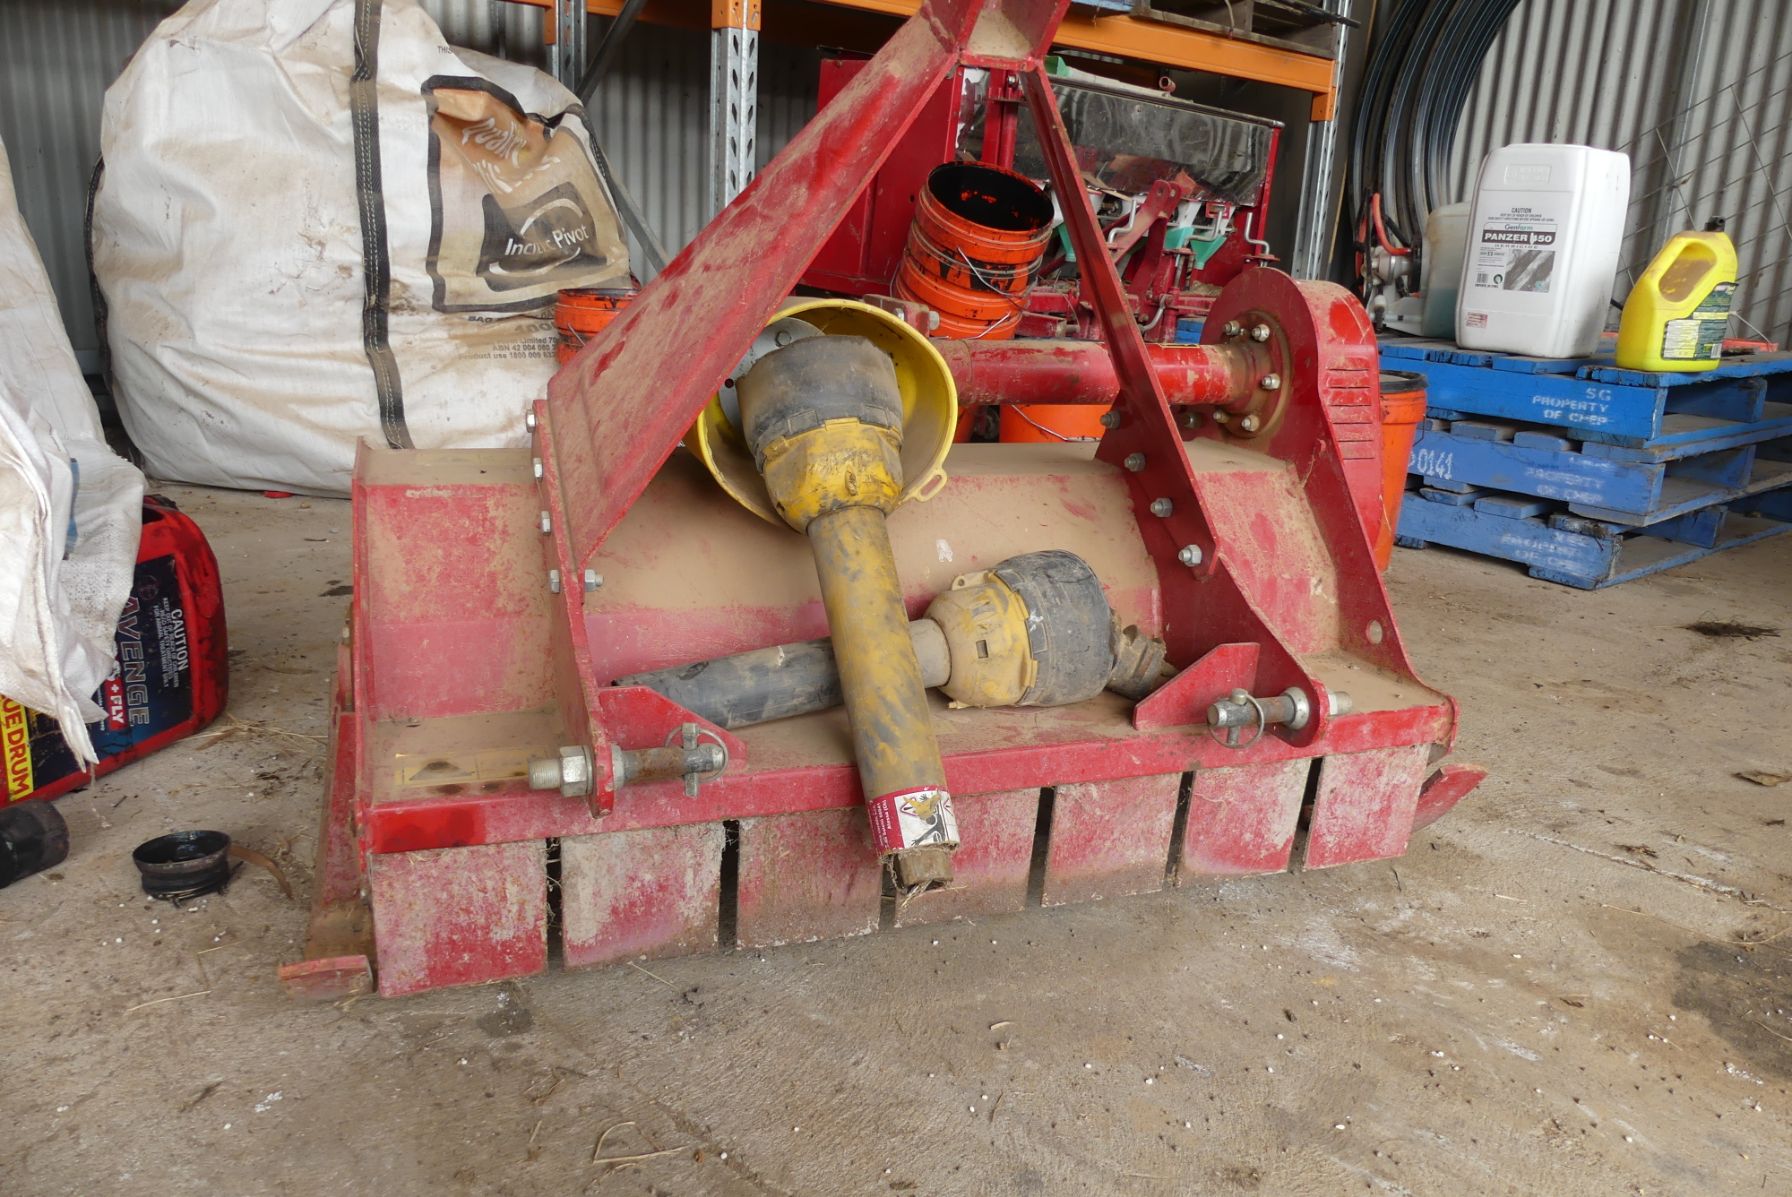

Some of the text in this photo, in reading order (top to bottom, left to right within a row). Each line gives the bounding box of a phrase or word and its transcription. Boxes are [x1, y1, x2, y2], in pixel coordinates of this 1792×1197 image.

[552, 224, 589, 249] Pivot
[1484, 232, 1528, 242] PANZER
[1532, 395, 1609, 413] PROPERTY
[1543, 409, 1563, 419] OF
[171, 608, 189, 672] CAUTION
[117, 595, 150, 726] AVENGE
[110, 694, 126, 724] FLY
[0, 693, 30, 796] UE DRUM
